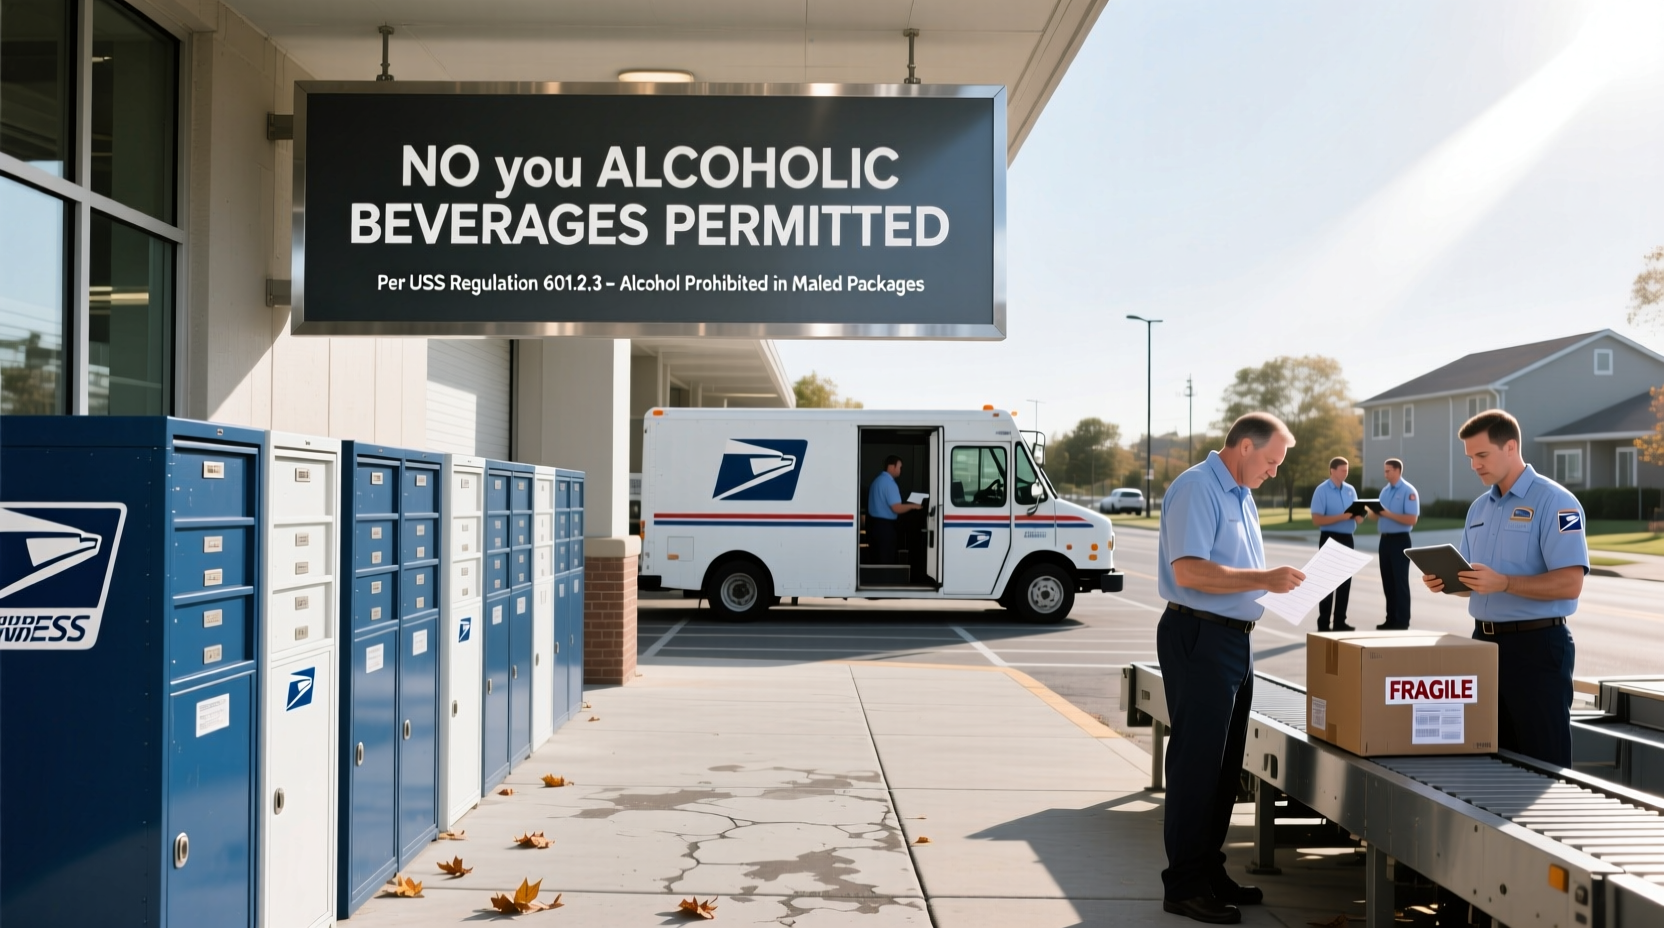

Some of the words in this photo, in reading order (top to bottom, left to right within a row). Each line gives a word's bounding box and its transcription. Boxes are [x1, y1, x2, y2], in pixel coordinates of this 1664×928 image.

[402, 144, 480, 188] NO
[494, 156, 583, 199] you
[596, 145, 900, 190] ALCOHOLIC
[350, 202, 649, 247] BEVERAGES
[665, 204, 950, 248] PERMITTED
[377, 274, 406, 291] Per
[409, 274, 446, 291] USS
[450, 273, 539, 297] Regulation
[619, 273, 680, 292] Alcohol
[684, 273, 769, 292] Prohibited
[773, 274, 788, 292] in
[791, 274, 843, 293] Maled
[847, 273, 926, 298] Packages
[1390, 679, 1474, 700] FRAGILE
